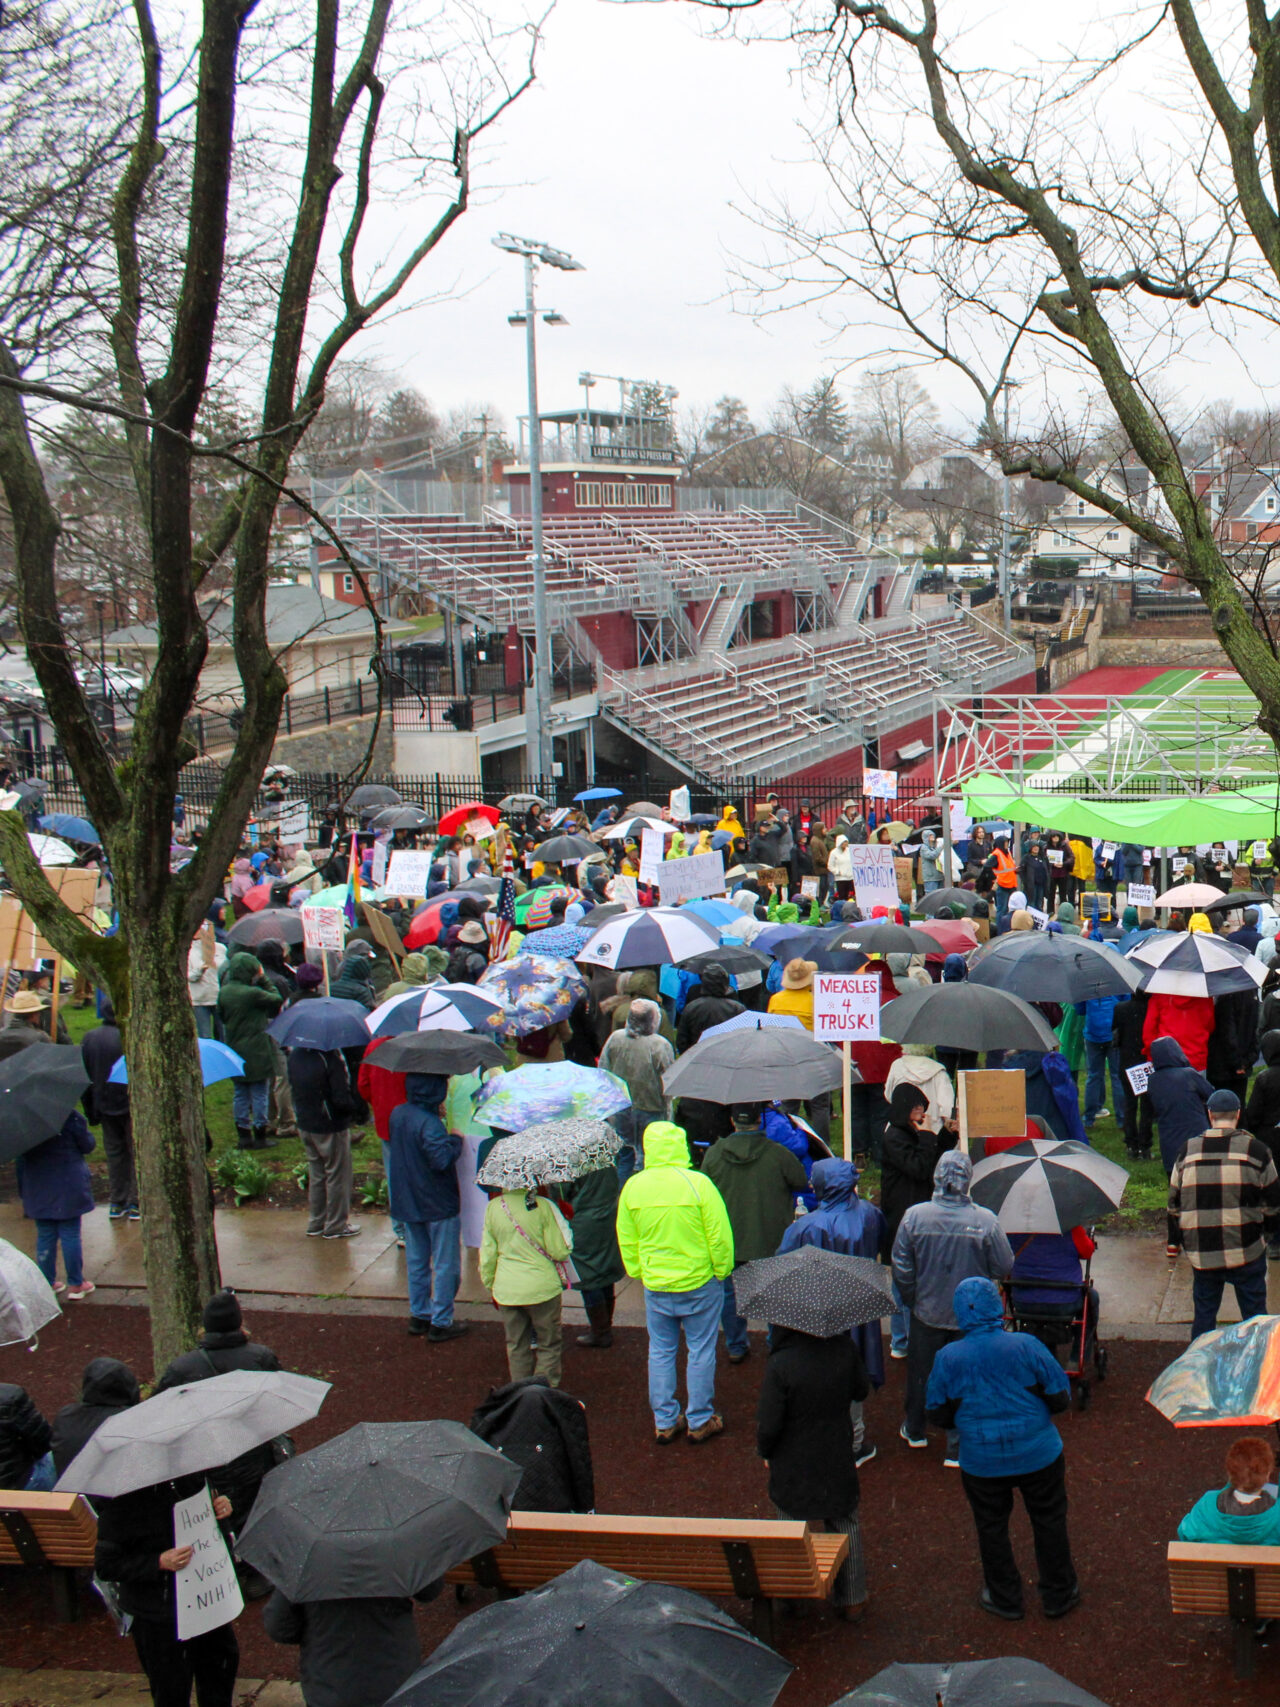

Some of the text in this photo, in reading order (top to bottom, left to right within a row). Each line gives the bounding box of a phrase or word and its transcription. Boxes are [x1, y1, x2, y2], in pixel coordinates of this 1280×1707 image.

[593, 446, 612, 457] LARRY
[853, 848, 891, 864] SAVE
[820, 978, 877, 994] MEASLES
[842, 998, 851, 1014] 4
[818, 1014, 874, 1030] TRUSK!
[1130, 1070, 1141, 1091] SPEECH
[1136, 1068, 1147, 1090] FREE
[196, 1584, 225, 1610] NIH
